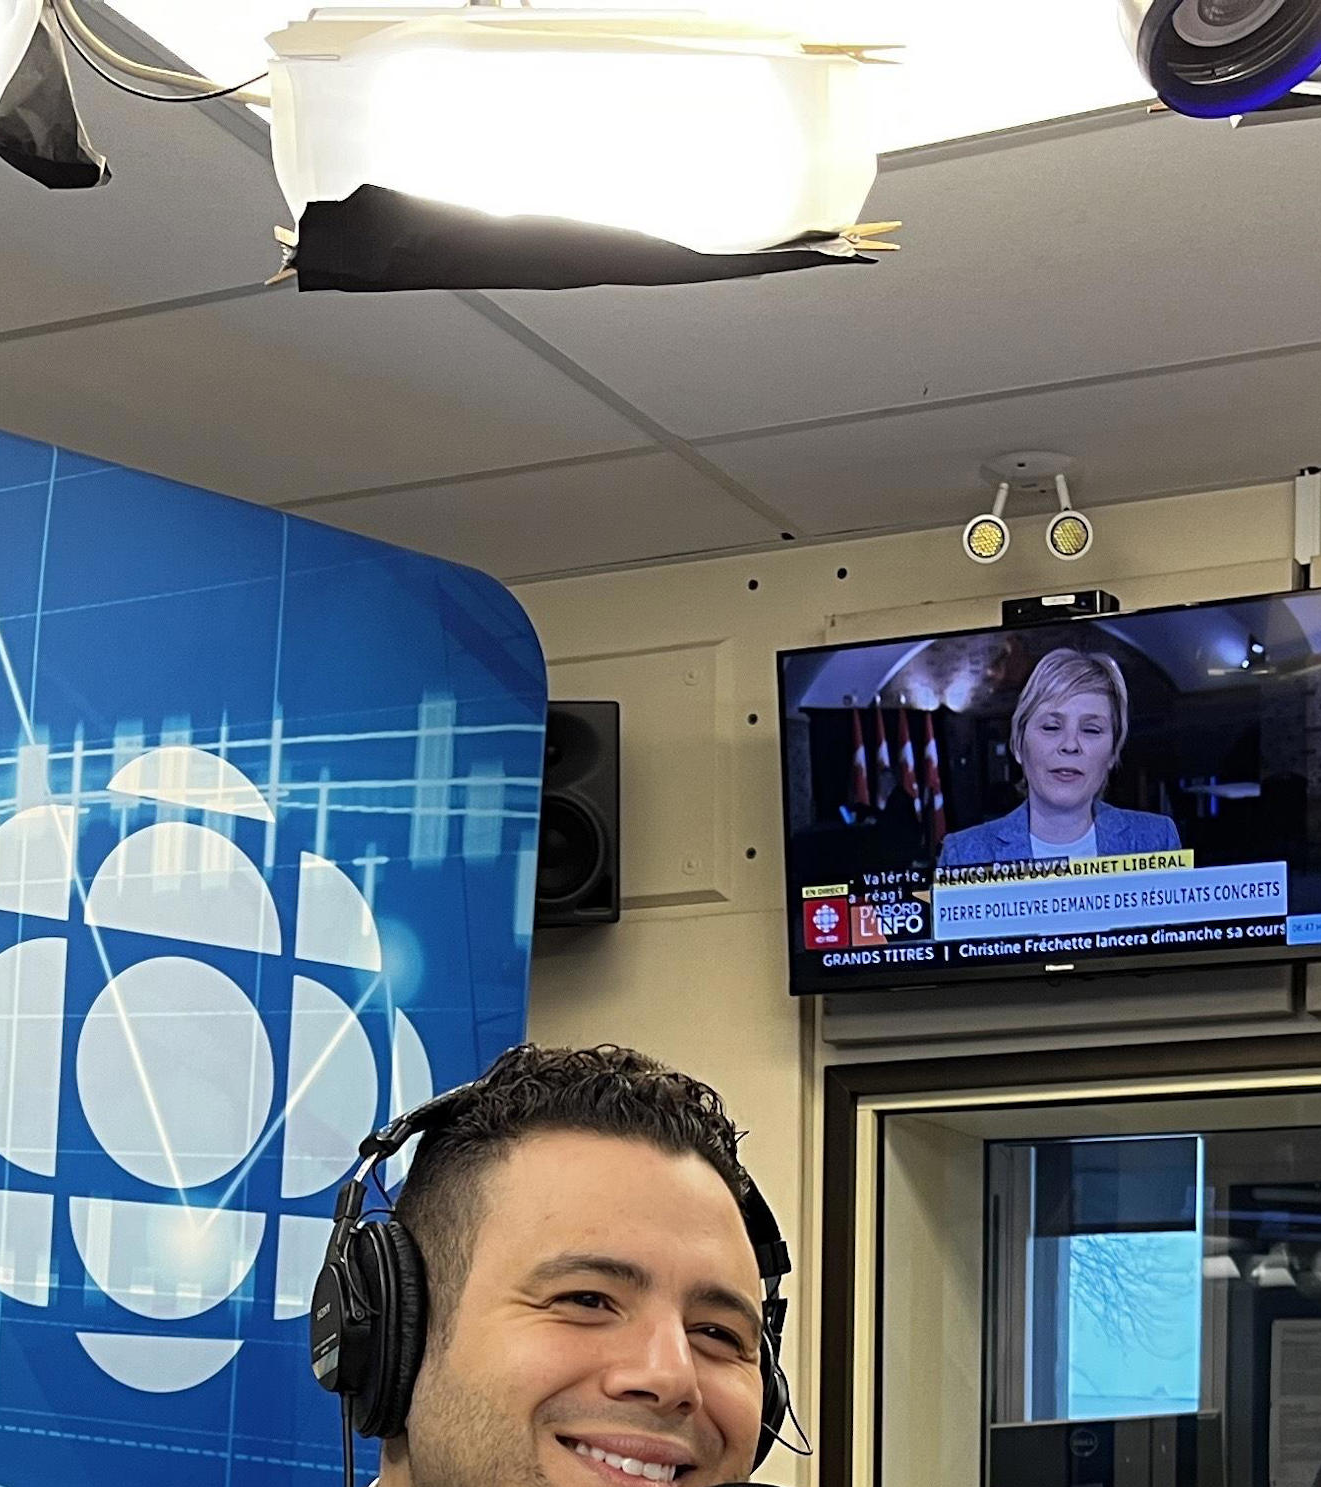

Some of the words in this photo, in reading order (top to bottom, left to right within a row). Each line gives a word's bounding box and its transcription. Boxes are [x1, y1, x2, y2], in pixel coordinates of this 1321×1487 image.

[935, 866, 986, 881] Pierre
[992, 859, 1069, 875] Poilievre
[1053, 860, 1119, 877] CABINET
[1123, 855, 1186, 872] LIBÉRAL
[848, 894, 856, 904] a
[864, 887, 903, 904] réagi
[940, 905, 982, 922] PIERRE
[985, 901, 1048, 919] POILIEVRE
[1052, 894, 1111, 913] DEMANDE
[1114, 892, 1138, 909] DES
[1141, 886, 1210, 906] RÉSULTATS
[1214, 881, 1280, 901] CONCRETS
[860, 902, 922, 919] D'ABORD
[822, 950, 881, 967] GRANDS
[883, 946, 935, 963] TITRES
[959, 941, 1021, 958] Christine
[1024, 934, 1092, 953] Fréchette
[1096, 932, 1148, 948] lancera
[1151, 926, 1222, 945] dimanche
[1226, 926, 1243, 939] sa
[1246, 922, 1286, 937] cours
